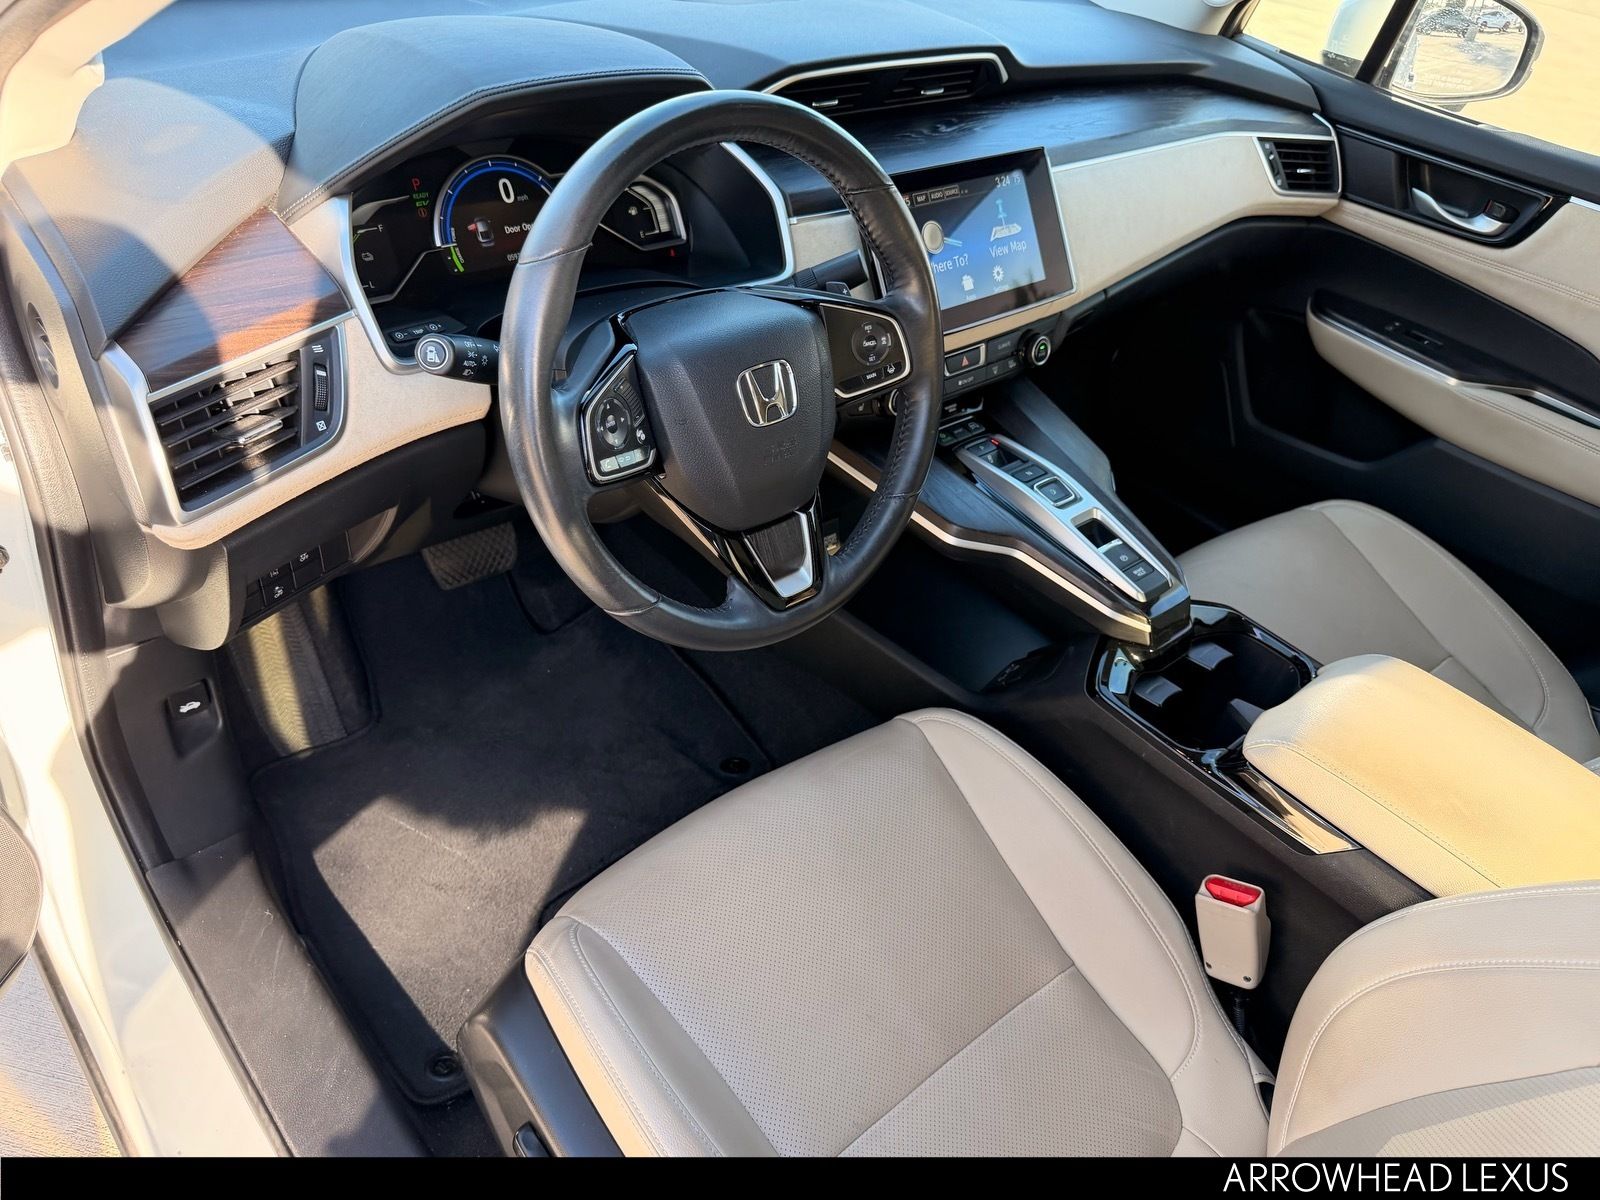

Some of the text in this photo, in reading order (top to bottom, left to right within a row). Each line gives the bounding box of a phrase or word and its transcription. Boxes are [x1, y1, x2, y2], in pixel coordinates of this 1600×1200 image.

[411, 177, 421, 191] P
[498, 178, 529, 204] 0 mph
[931, 191, 943, 199] AUDIO
[916, 194, 926, 202] MAP
[378, 224, 384, 232] F
[504, 226, 521, 234] Door
[989, 240, 1027, 258] View Map
[931, 253, 969, 273] here To?
